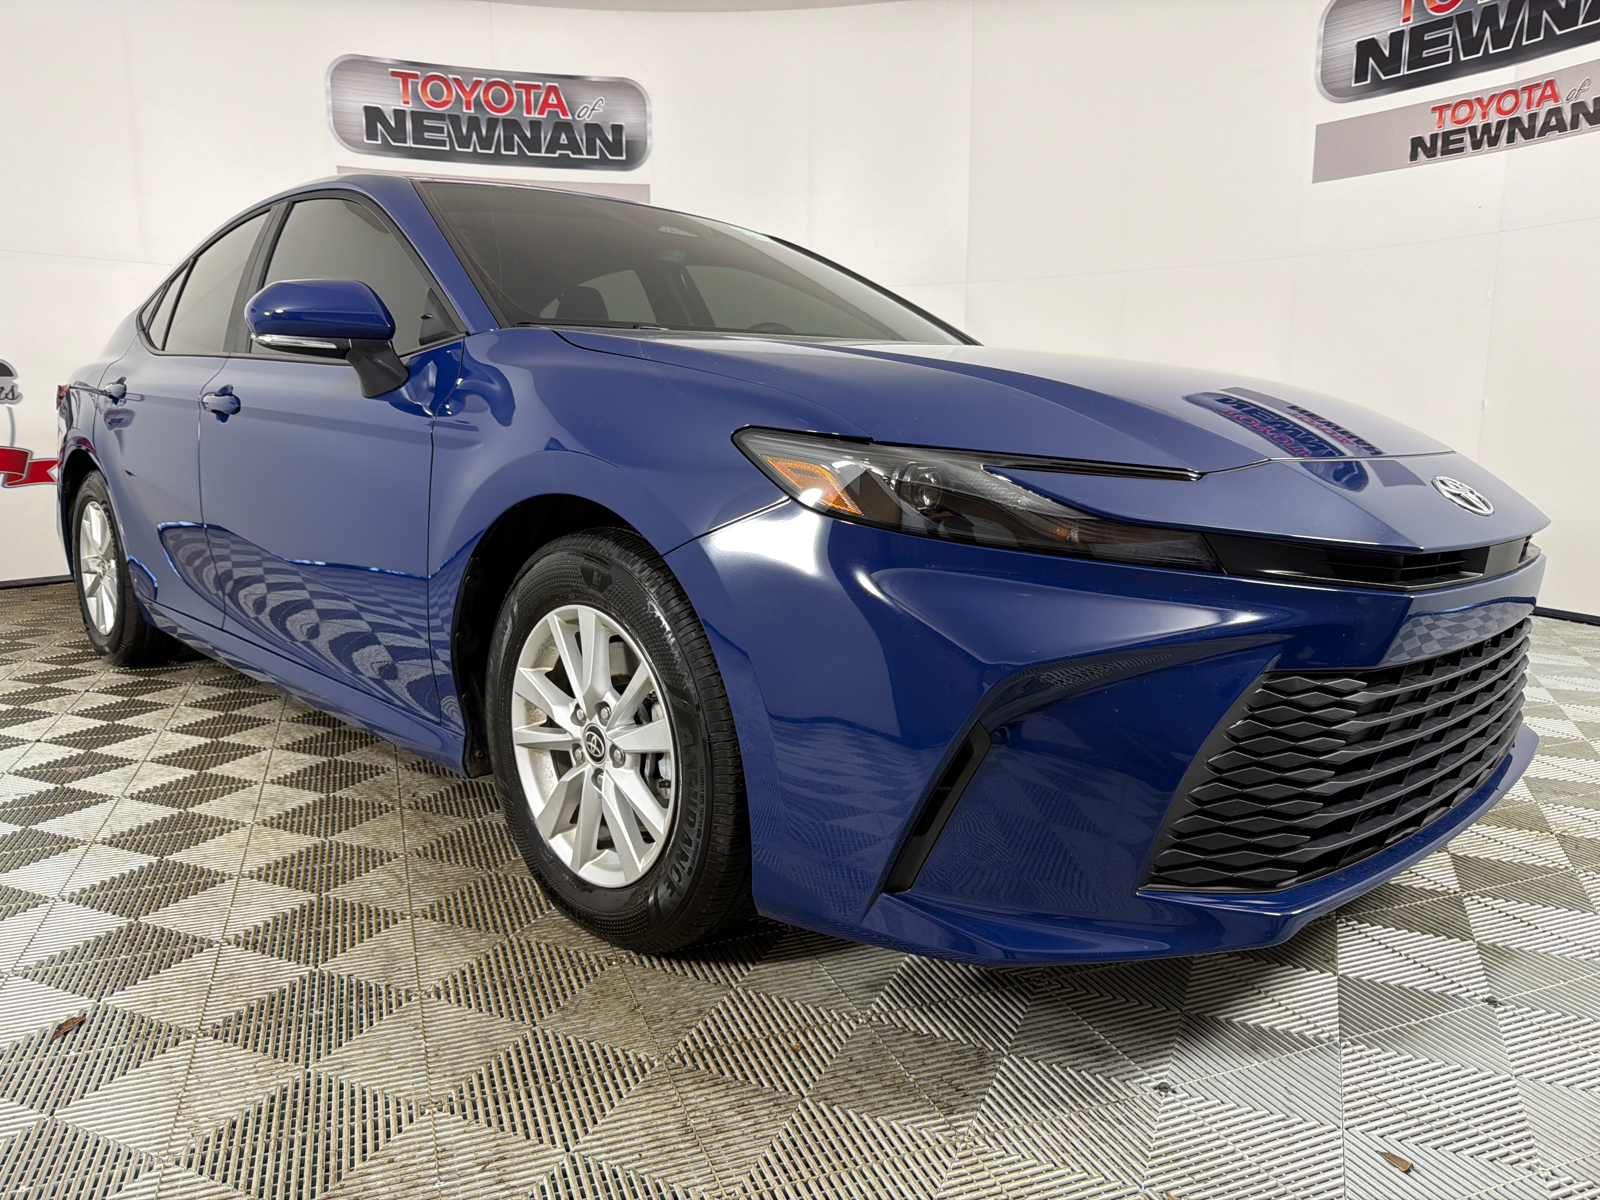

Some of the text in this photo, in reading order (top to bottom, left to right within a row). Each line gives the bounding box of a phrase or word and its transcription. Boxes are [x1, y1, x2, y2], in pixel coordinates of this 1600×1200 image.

[1351, 0, 1600, 87] NEWN
[389, 68, 605, 121] TOYOTA of
[1430, 77, 1592, 130] TOYOTA of
[362, 105, 626, 160] NEWNAN
[1407, 95, 1600, 164] NEWNAN
